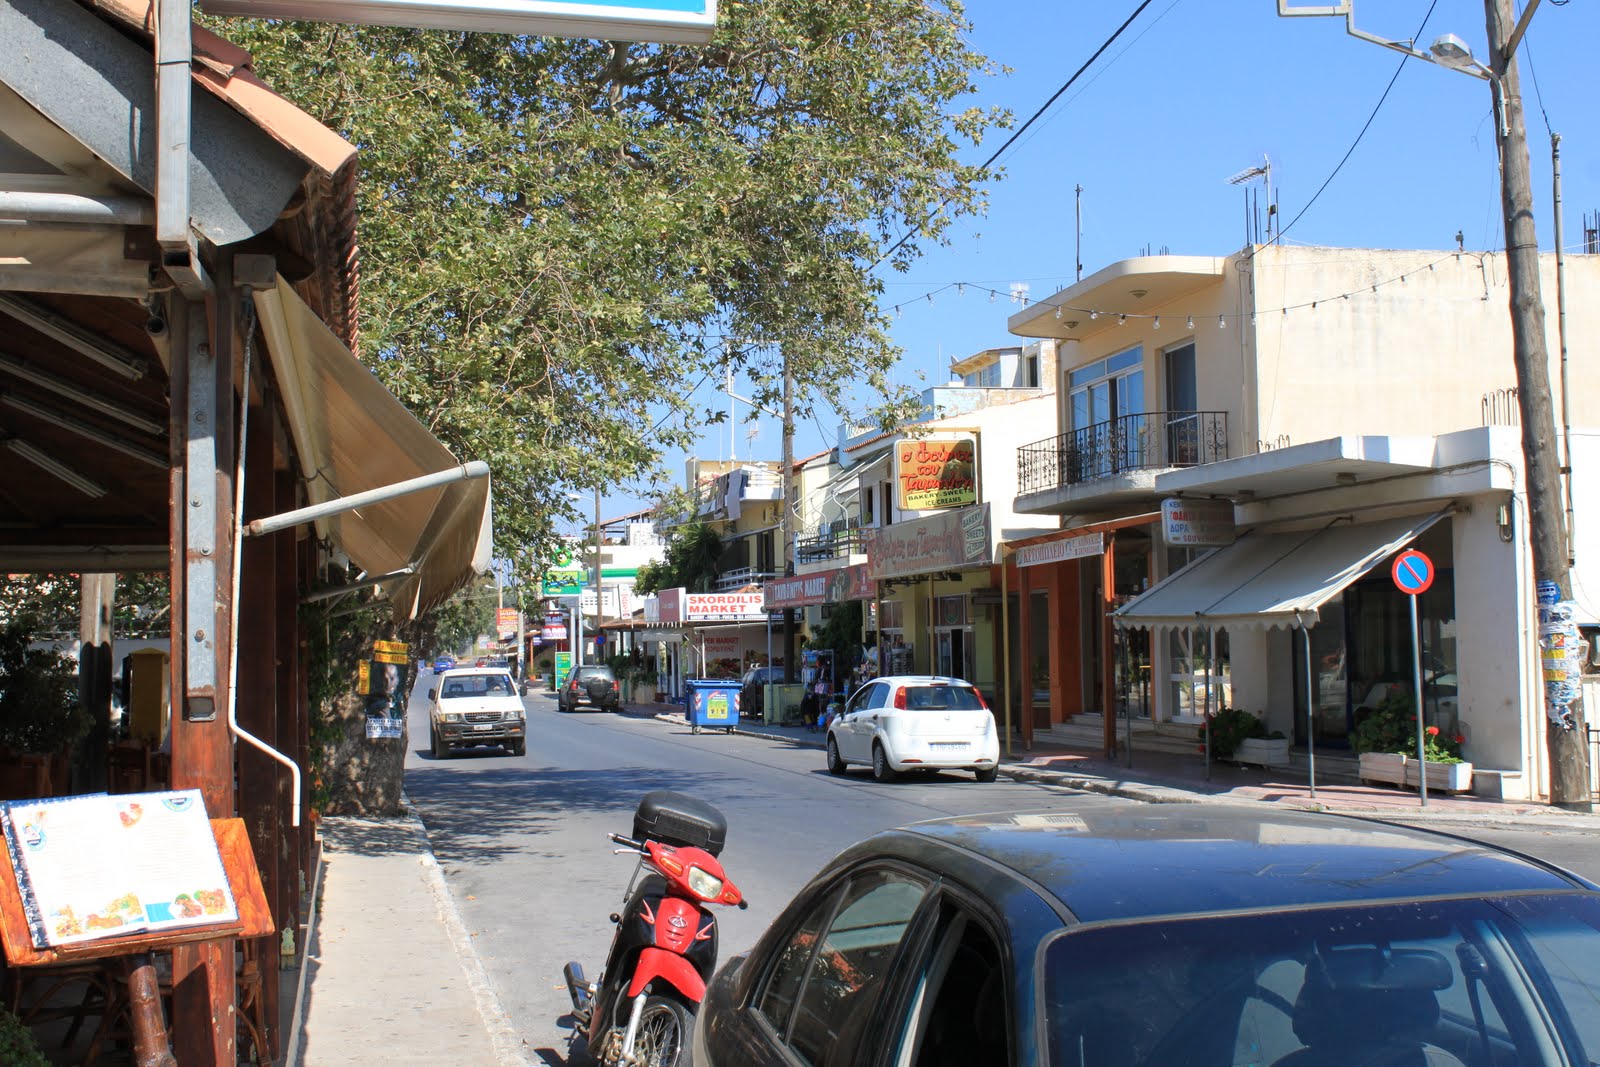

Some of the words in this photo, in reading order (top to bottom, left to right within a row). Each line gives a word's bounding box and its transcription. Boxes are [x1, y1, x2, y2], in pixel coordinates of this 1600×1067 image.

[937, 496, 962, 505] CREAMS
[963, 512, 983, 527] BAKERY
[966, 528, 984, 540] SWEETS
[804, 577, 826, 597] MARKET
[689, 595, 762, 604] SKORDILIS
[689, 605, 746, 613] MARKET
